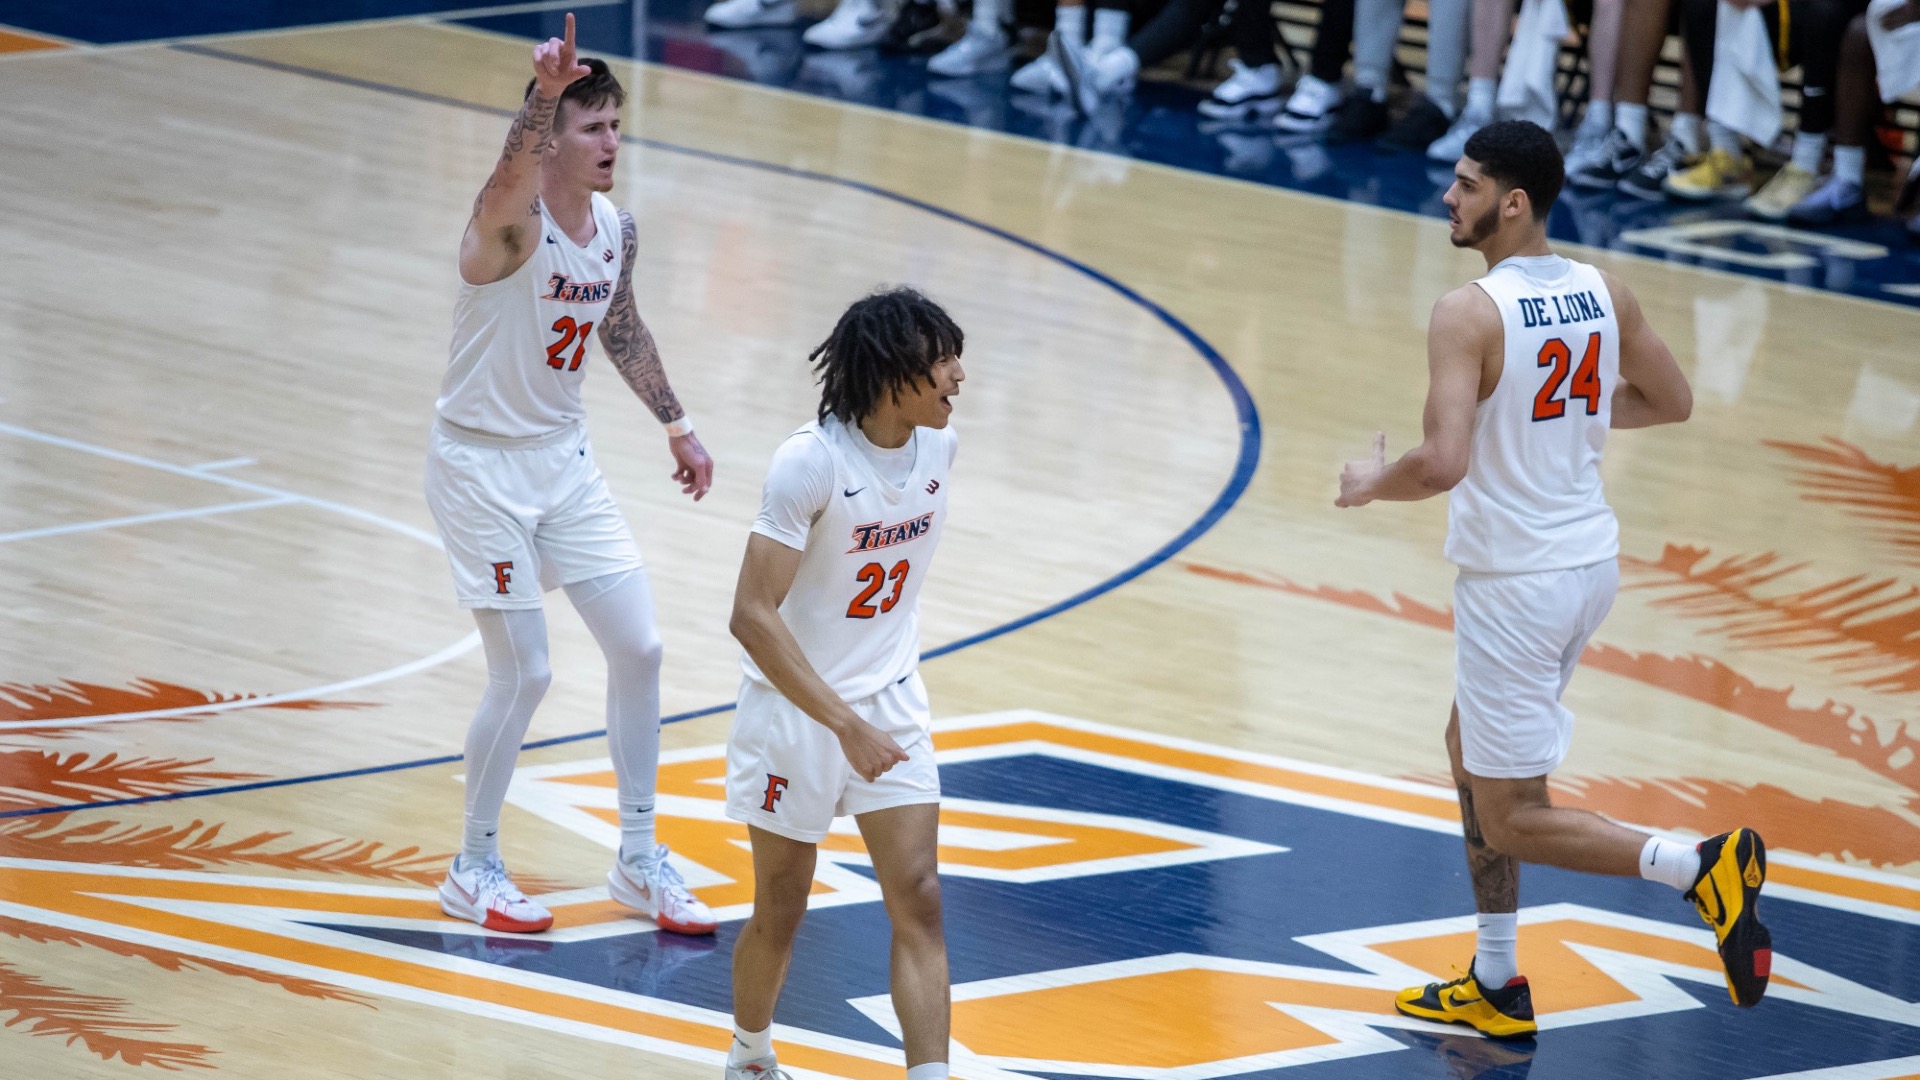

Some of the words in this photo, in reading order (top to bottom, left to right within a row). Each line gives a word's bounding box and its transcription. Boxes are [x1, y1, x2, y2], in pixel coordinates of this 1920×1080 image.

[1517, 297, 1553, 328] DE
[1551, 290, 1605, 324] LUNA
[546, 315, 594, 372] 21
[1531, 331, 1602, 422] 24
[490, 560, 514, 594] F
[845, 559, 911, 619] 23
[760, 772, 789, 814] F
